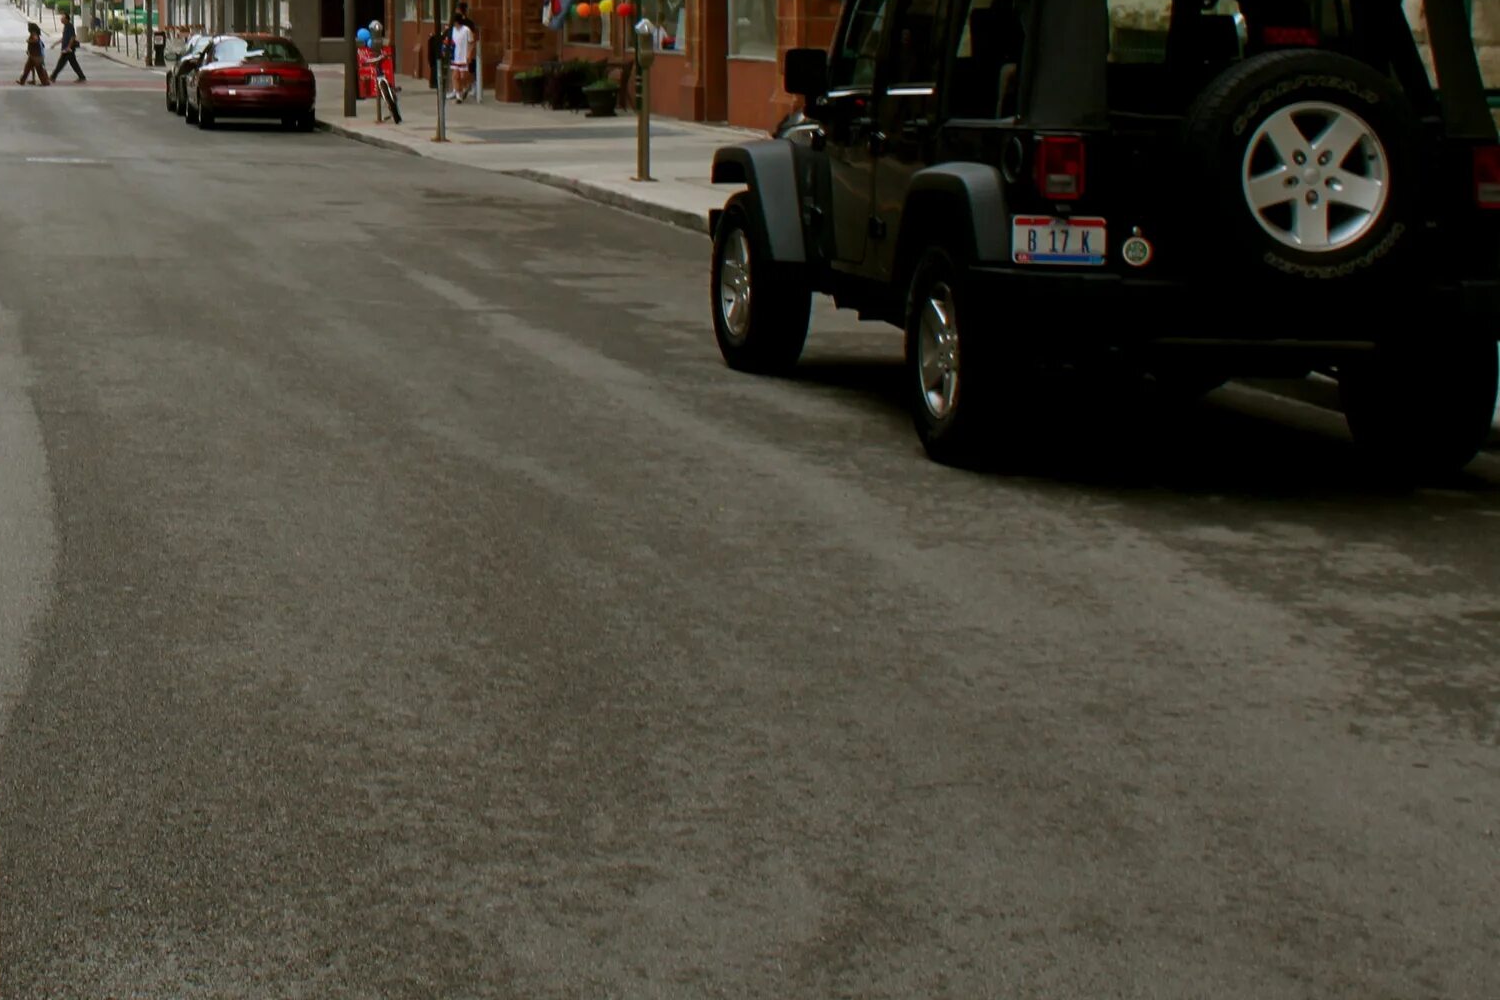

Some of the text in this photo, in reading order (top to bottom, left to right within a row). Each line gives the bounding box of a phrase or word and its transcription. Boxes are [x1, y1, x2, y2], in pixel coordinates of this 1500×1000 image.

[1028, 228, 1090, 254] B 17 K
